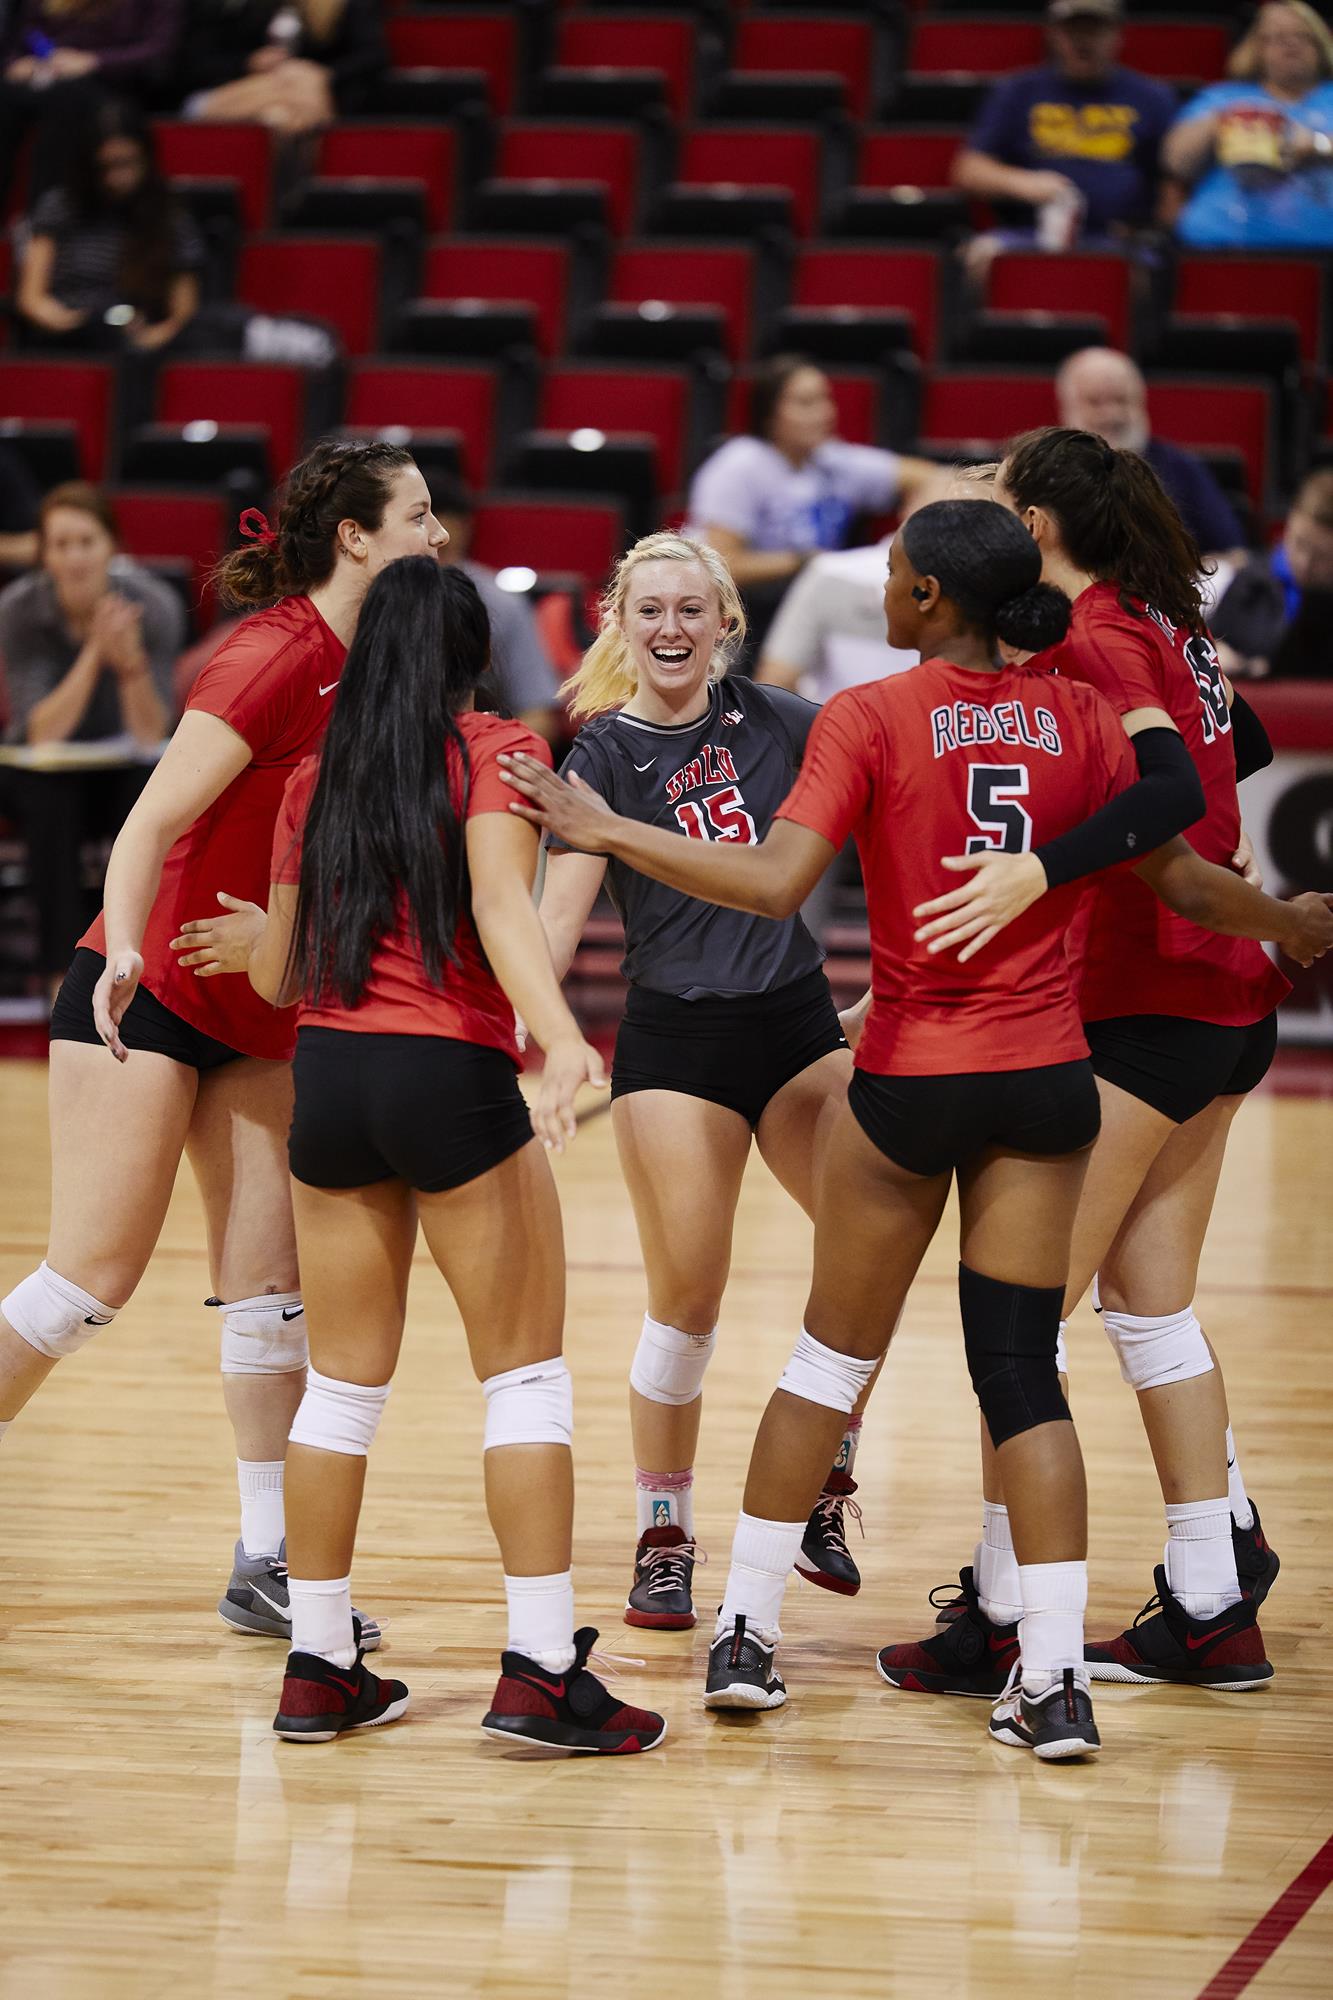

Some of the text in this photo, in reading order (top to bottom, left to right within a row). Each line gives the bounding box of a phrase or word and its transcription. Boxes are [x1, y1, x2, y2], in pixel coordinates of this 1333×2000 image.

[930, 700, 1063, 759] REBELS
[665, 744, 739, 805] UNLV
[674, 785, 759, 847] 15
[965, 763, 1033, 856] 5
